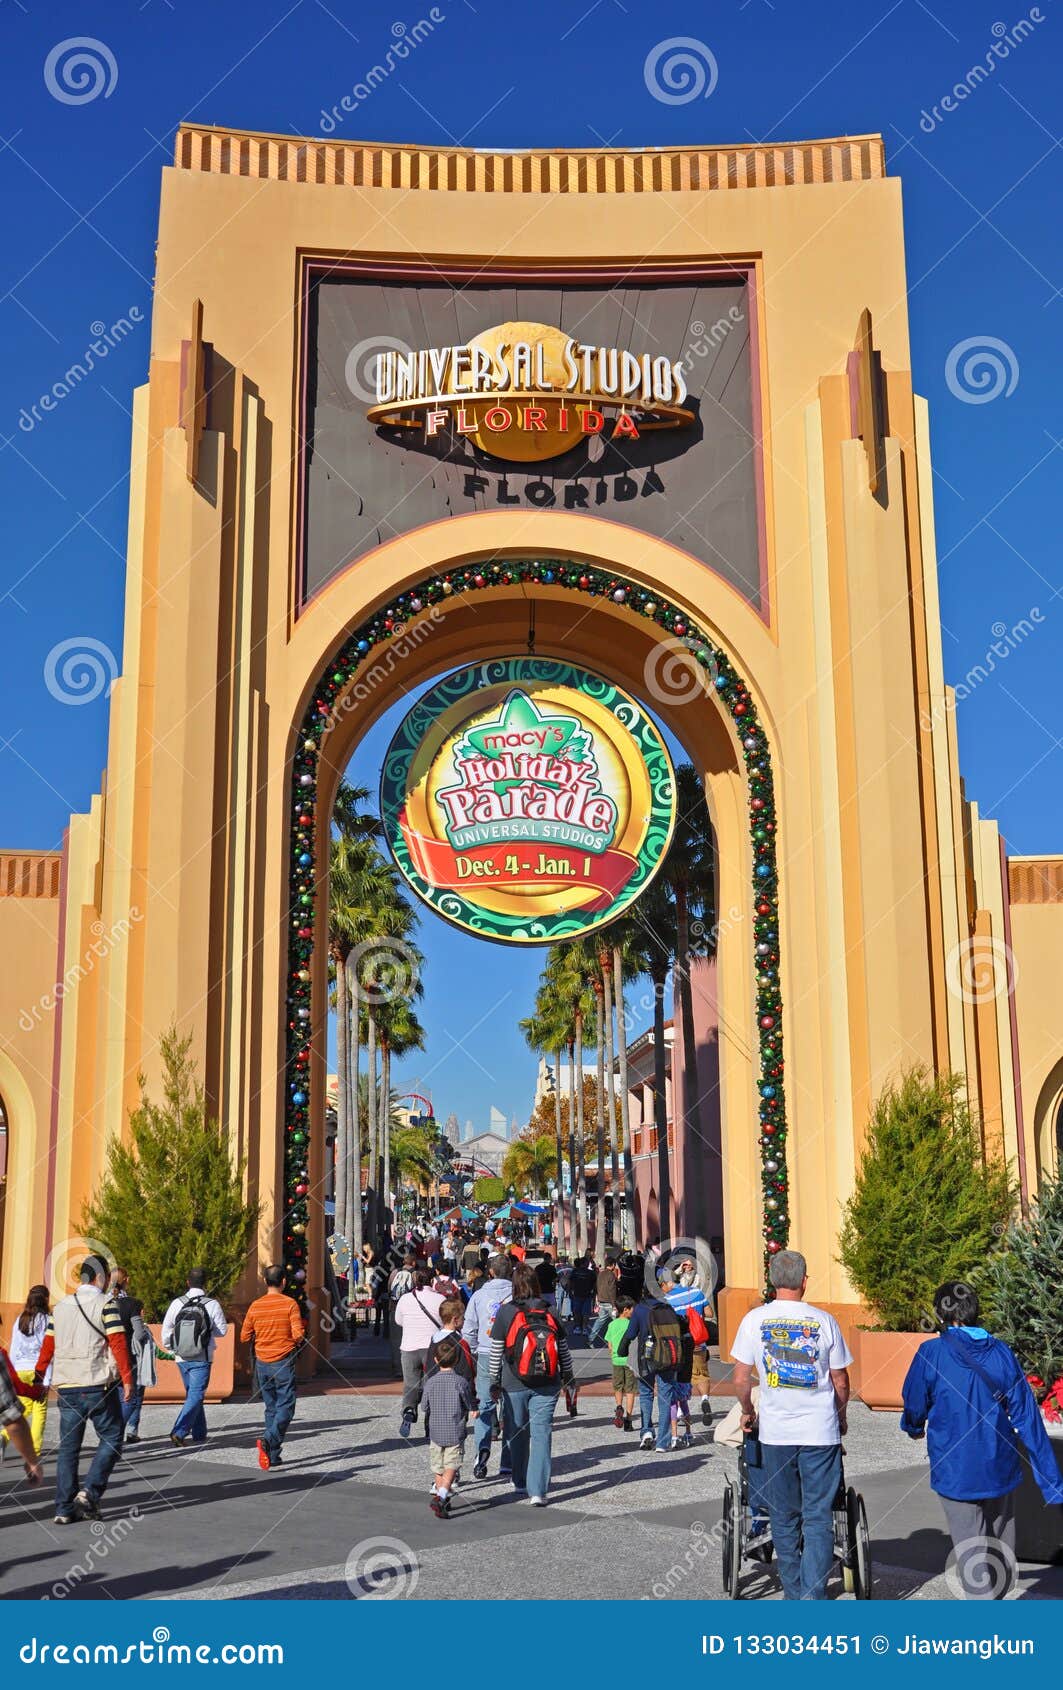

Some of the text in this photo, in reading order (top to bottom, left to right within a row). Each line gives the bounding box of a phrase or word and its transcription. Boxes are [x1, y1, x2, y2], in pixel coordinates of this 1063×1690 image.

[376, 339, 687, 407] UNIVERSAL STUDIOS
[427, 407, 640, 440] FLORIDA
[483, 726, 565, 750] macy's
[460, 752, 592, 791] Holiday
[441, 781, 615, 834] Parade
[454, 824, 604, 850] UNIVERSAL STUDIOS
[455, 855, 501, 879] Dec.
[534, 853, 577, 877] Jan.
[583, 856, 592, 877] 1
